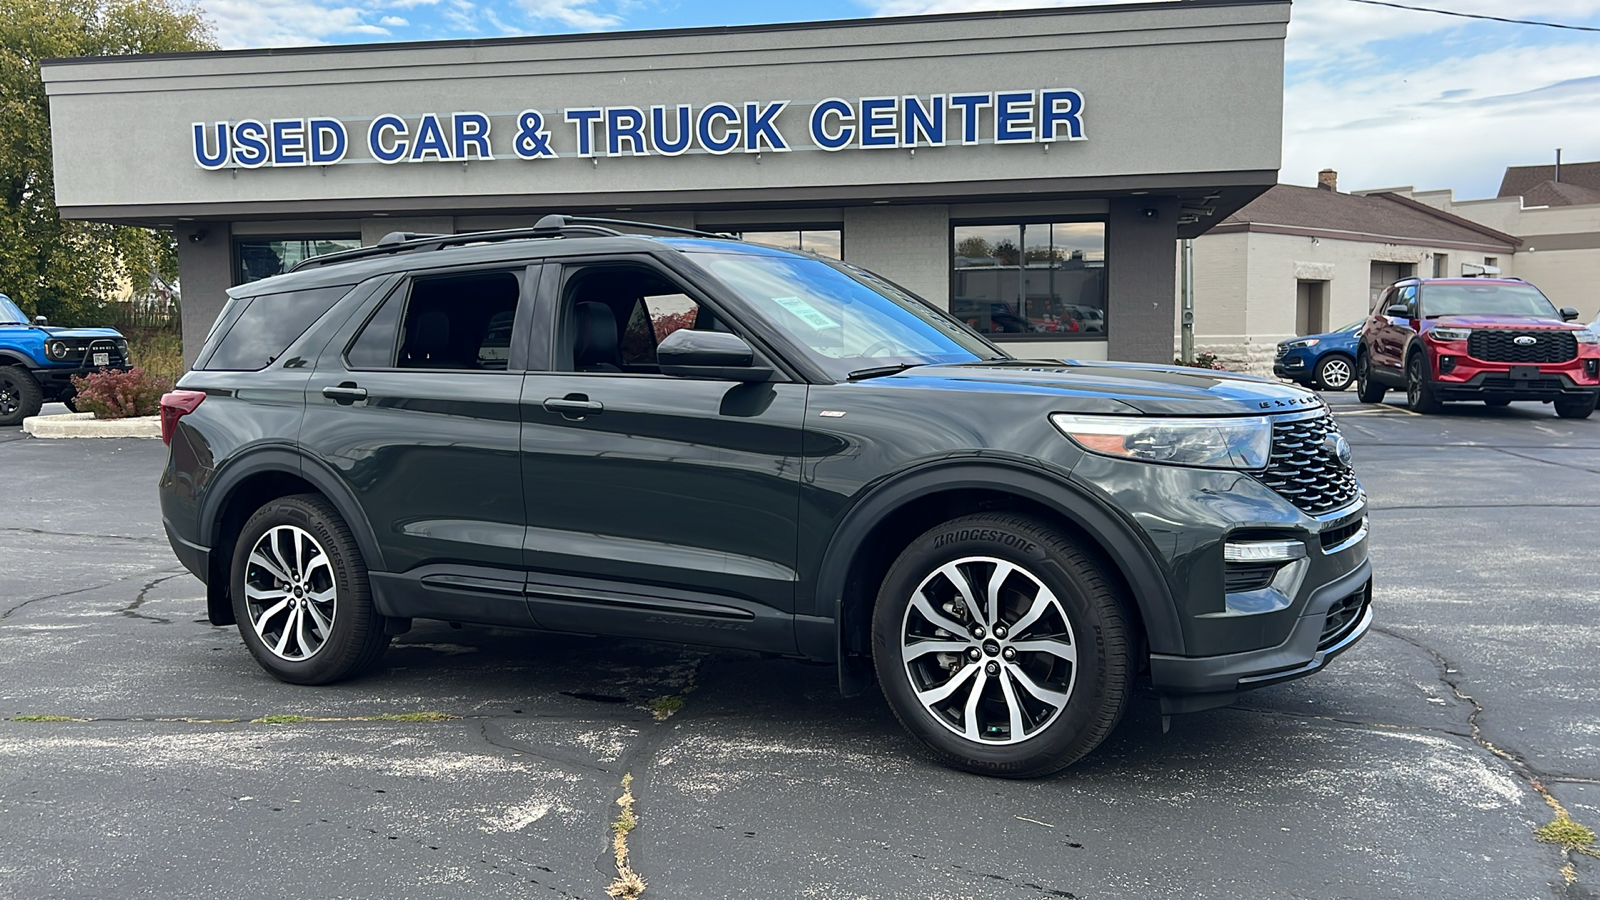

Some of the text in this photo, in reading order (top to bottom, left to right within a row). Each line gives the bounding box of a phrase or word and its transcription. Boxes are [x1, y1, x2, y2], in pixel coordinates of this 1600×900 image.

[191, 87, 1089, 171] USED CAR & TRUCK CENTER
[314, 521, 350, 594] BRIDGESTONE
[933, 529, 1037, 554] BRIDGESTONE
